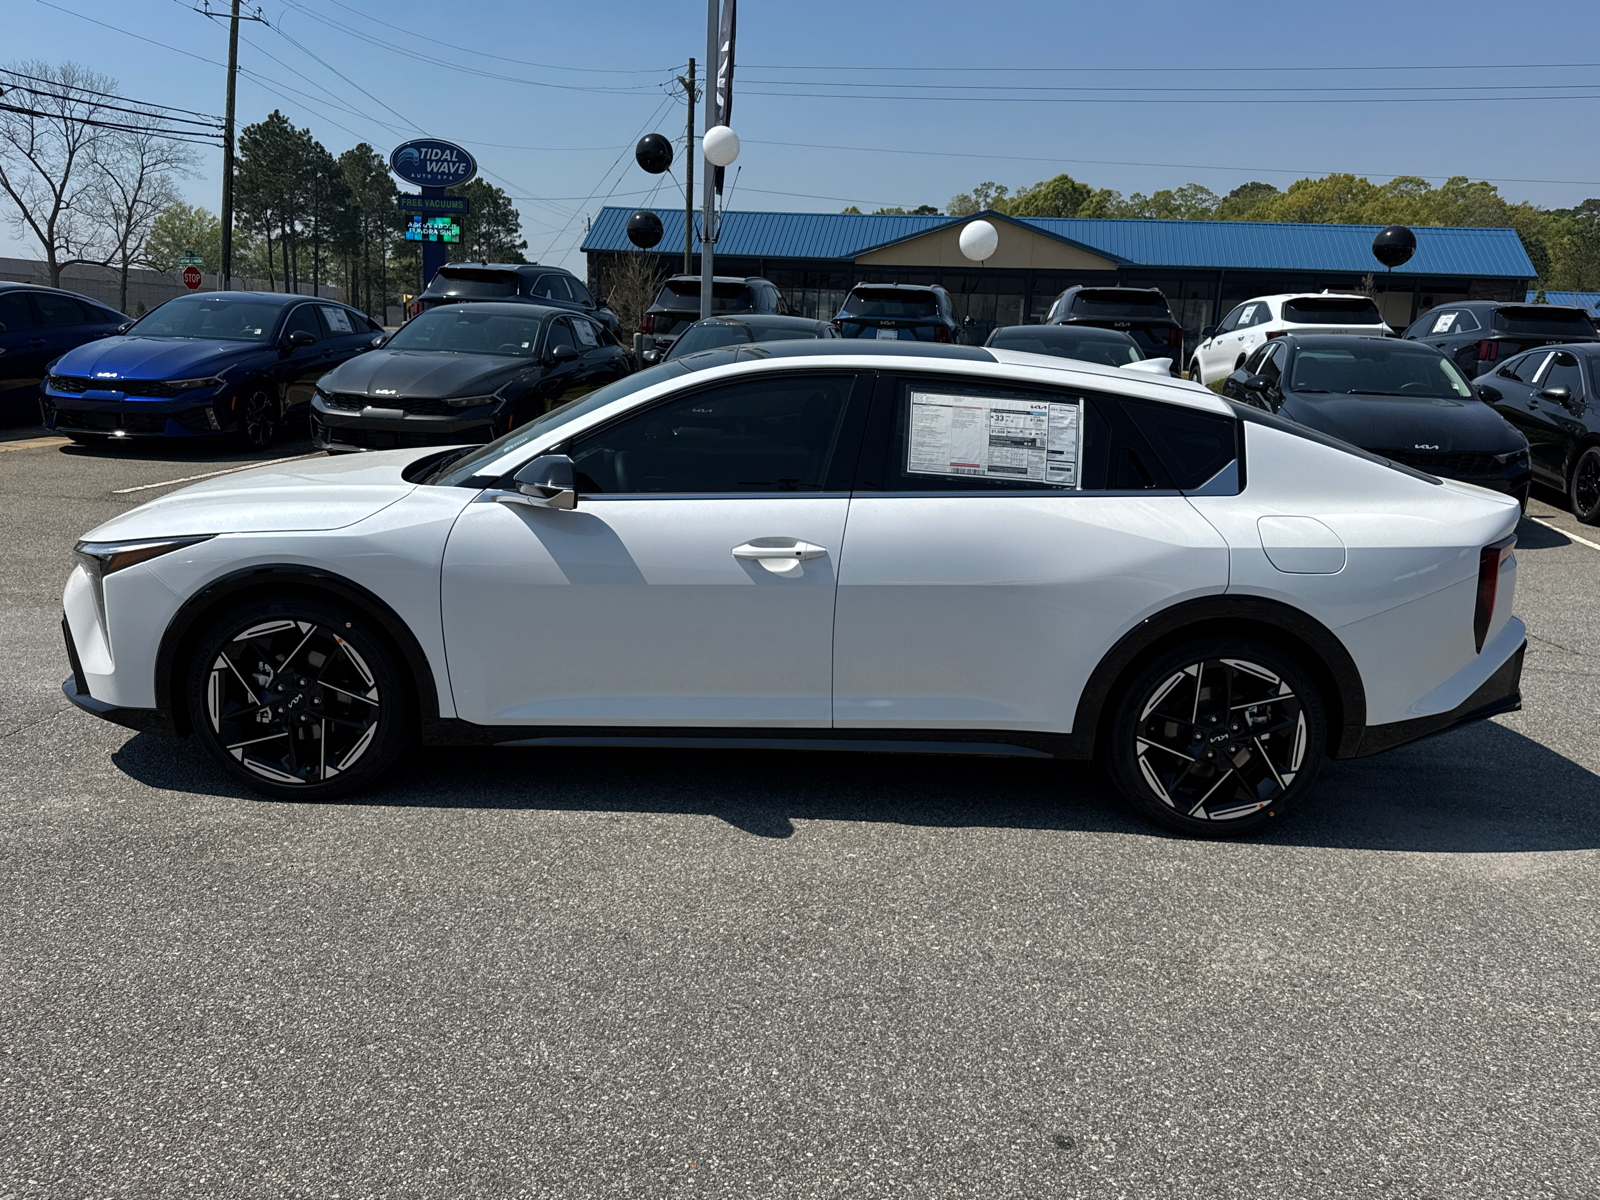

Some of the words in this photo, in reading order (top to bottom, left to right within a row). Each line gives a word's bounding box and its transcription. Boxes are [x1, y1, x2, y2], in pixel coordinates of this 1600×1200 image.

[420, 148, 458, 161] TIDAL
[426, 161, 467, 174] WAVE
[401, 198, 422, 207] FREE
[424, 200, 464, 209] VACUUMS
[184, 273, 200, 283] STOP
[193, 647, 210, 698] KUMHO
[1306, 691, 1321, 742] KUMHO
